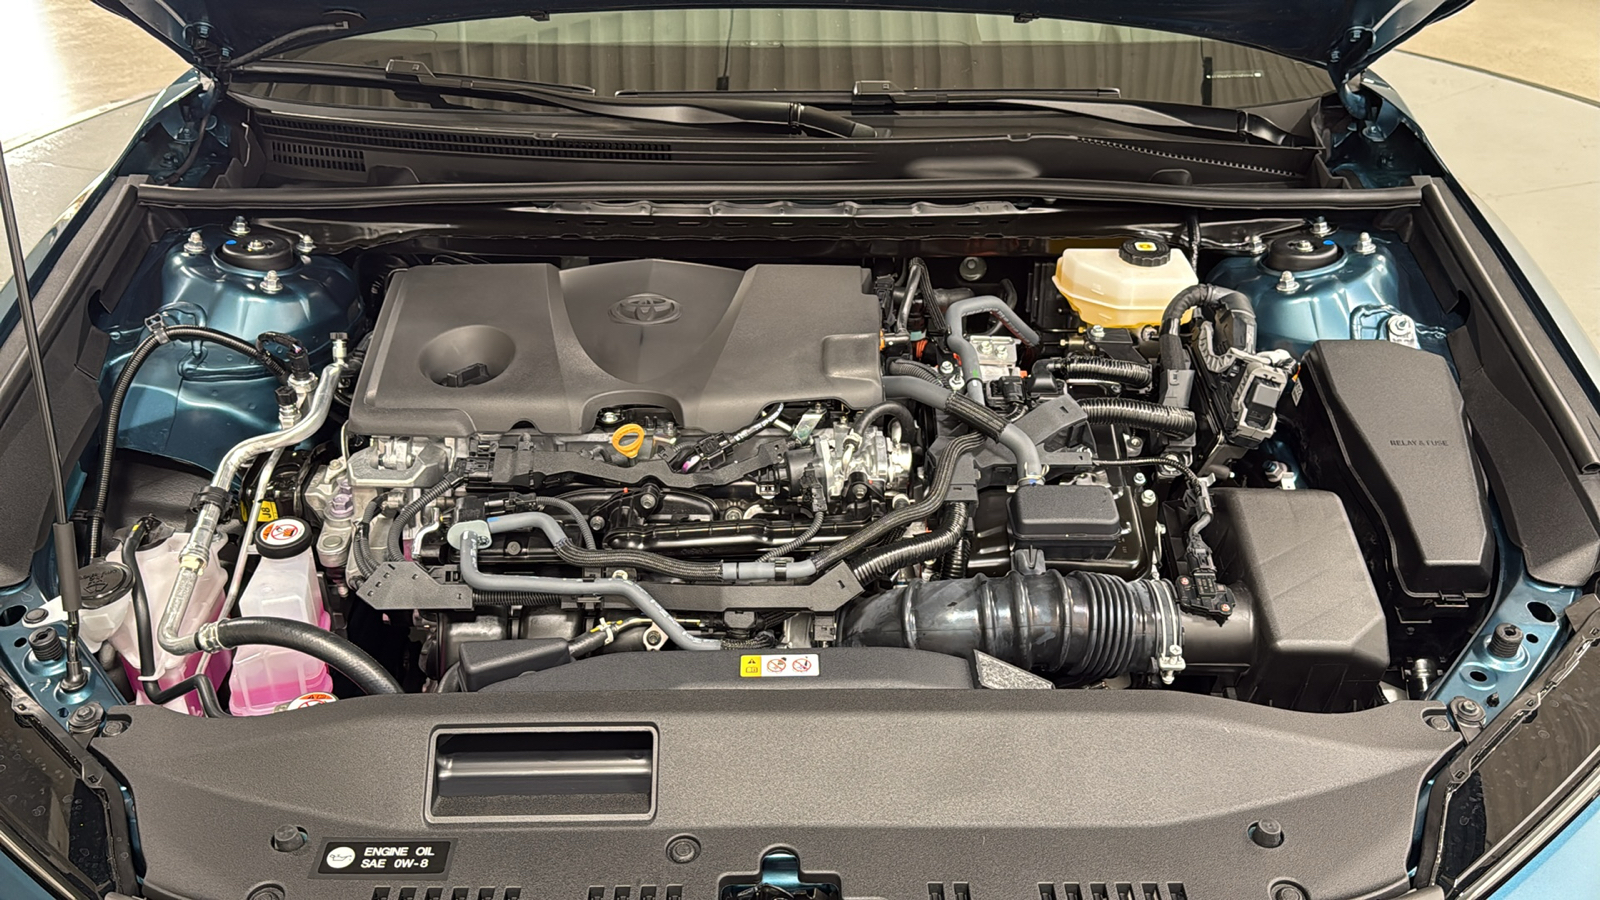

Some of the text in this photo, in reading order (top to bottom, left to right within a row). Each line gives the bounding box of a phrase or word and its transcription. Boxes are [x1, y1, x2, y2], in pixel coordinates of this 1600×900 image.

[364, 846, 435, 857] ENGINE OIL
[360, 858, 429, 868] SAE 0W-8
